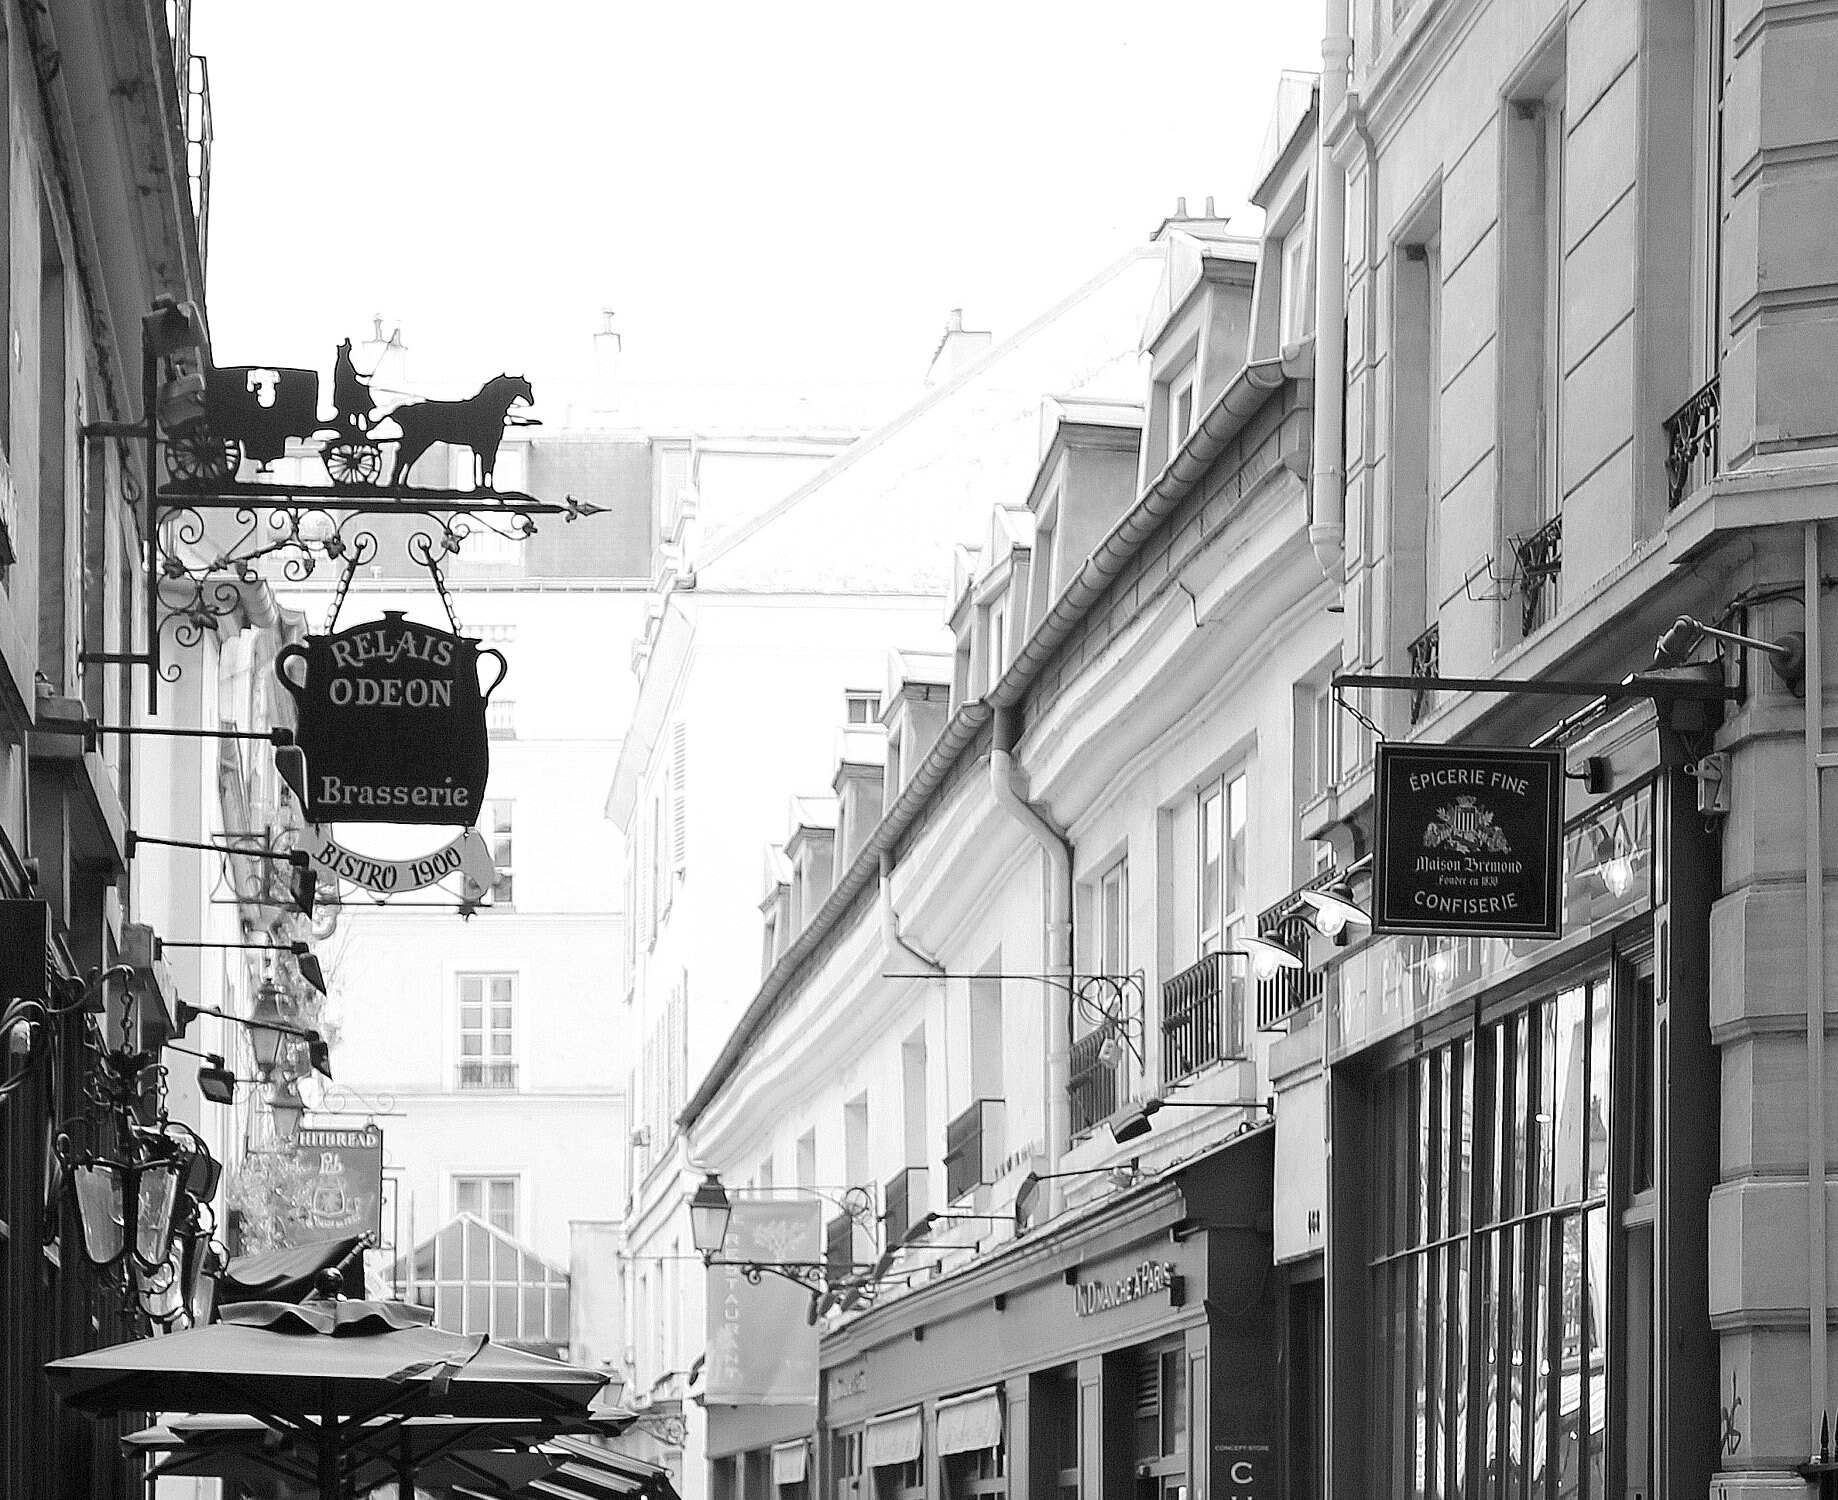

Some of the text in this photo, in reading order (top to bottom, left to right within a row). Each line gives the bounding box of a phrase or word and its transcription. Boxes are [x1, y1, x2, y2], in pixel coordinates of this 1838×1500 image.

[330, 630, 454, 667] RELAIS
[330, 678, 453, 706] ODEON
[317, 776, 469, 806] Brasserie
[1410, 769, 1529, 796] ÉPICERIE FINE
[312, 842, 462, 890] BISTRO 1900
[1415, 856, 1461, 872] Maison
[1414, 890, 1518, 914] CONFISERIE
[297, 1131, 379, 1149] HITBREAD
